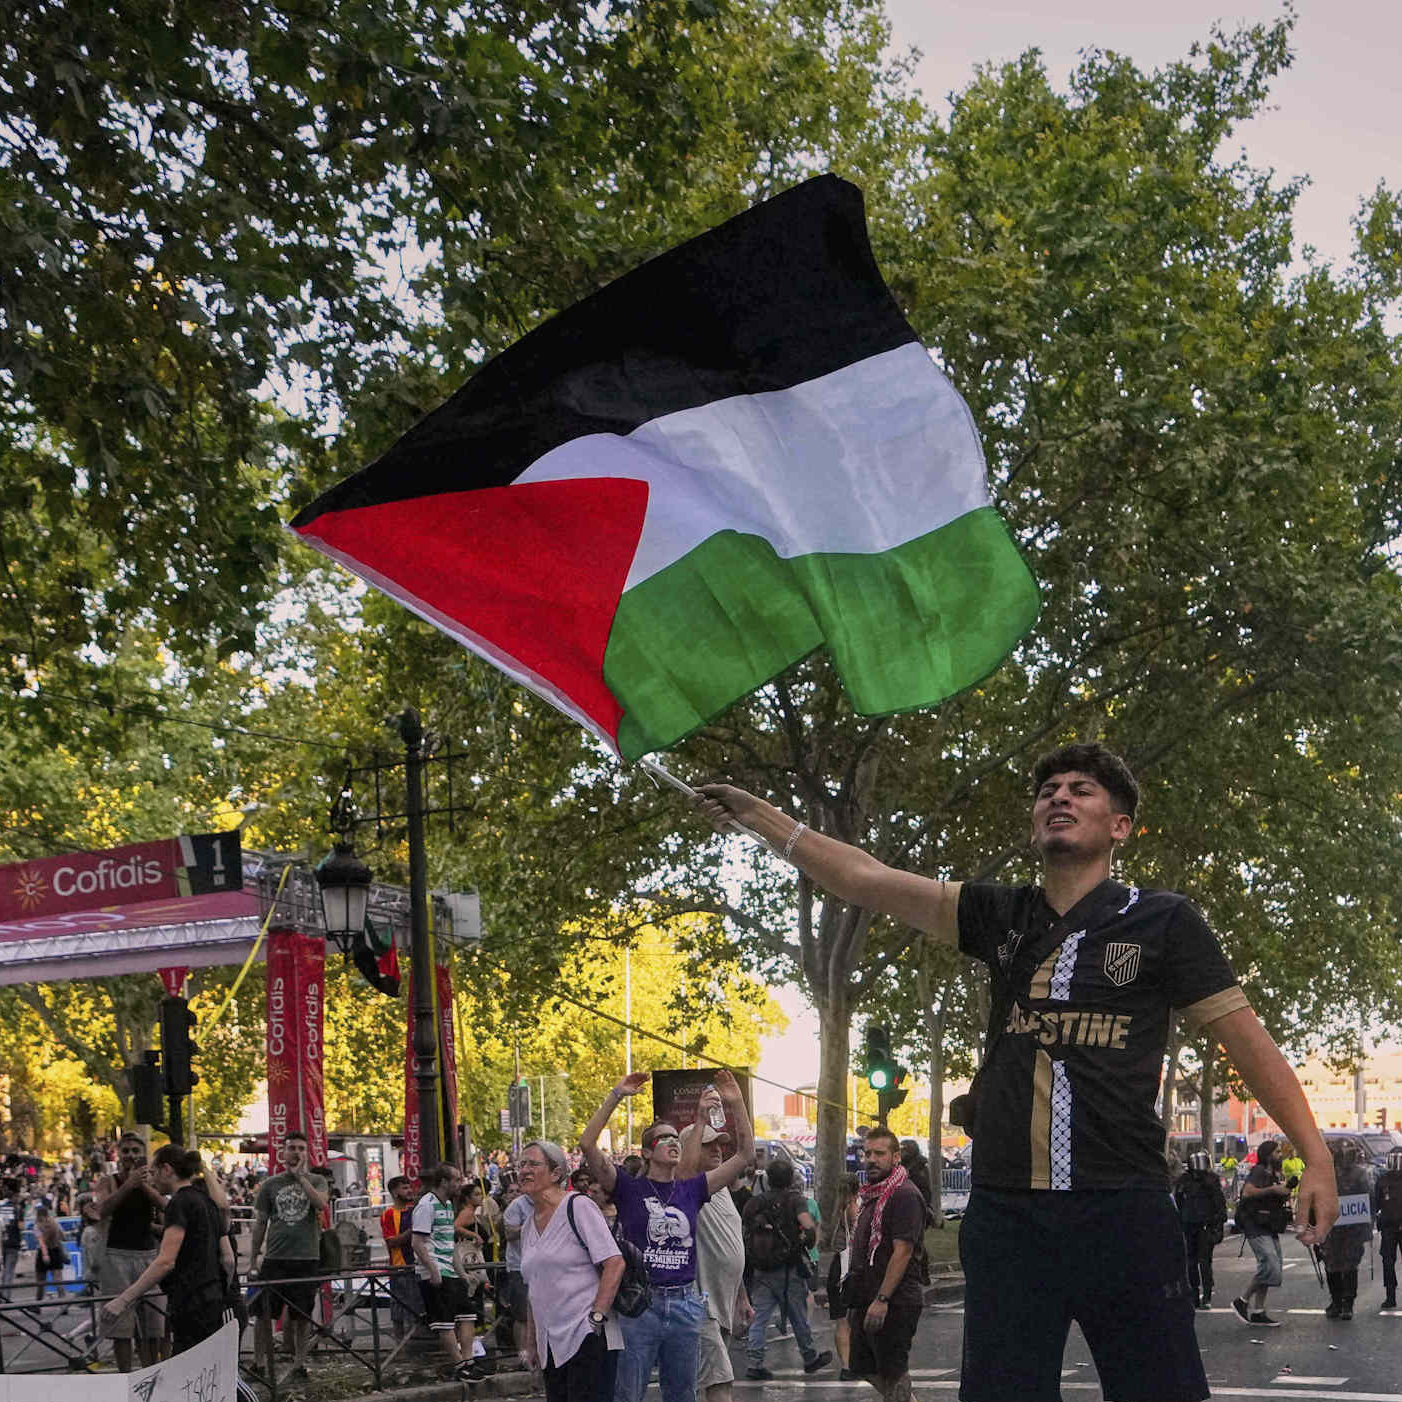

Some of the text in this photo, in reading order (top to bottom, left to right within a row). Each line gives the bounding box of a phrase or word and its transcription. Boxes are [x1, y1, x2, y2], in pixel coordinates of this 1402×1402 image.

[53, 855, 163, 896] Cofidis
[270, 977, 285, 1055] Cofidis
[305, 983, 319, 1060] Cofidis
